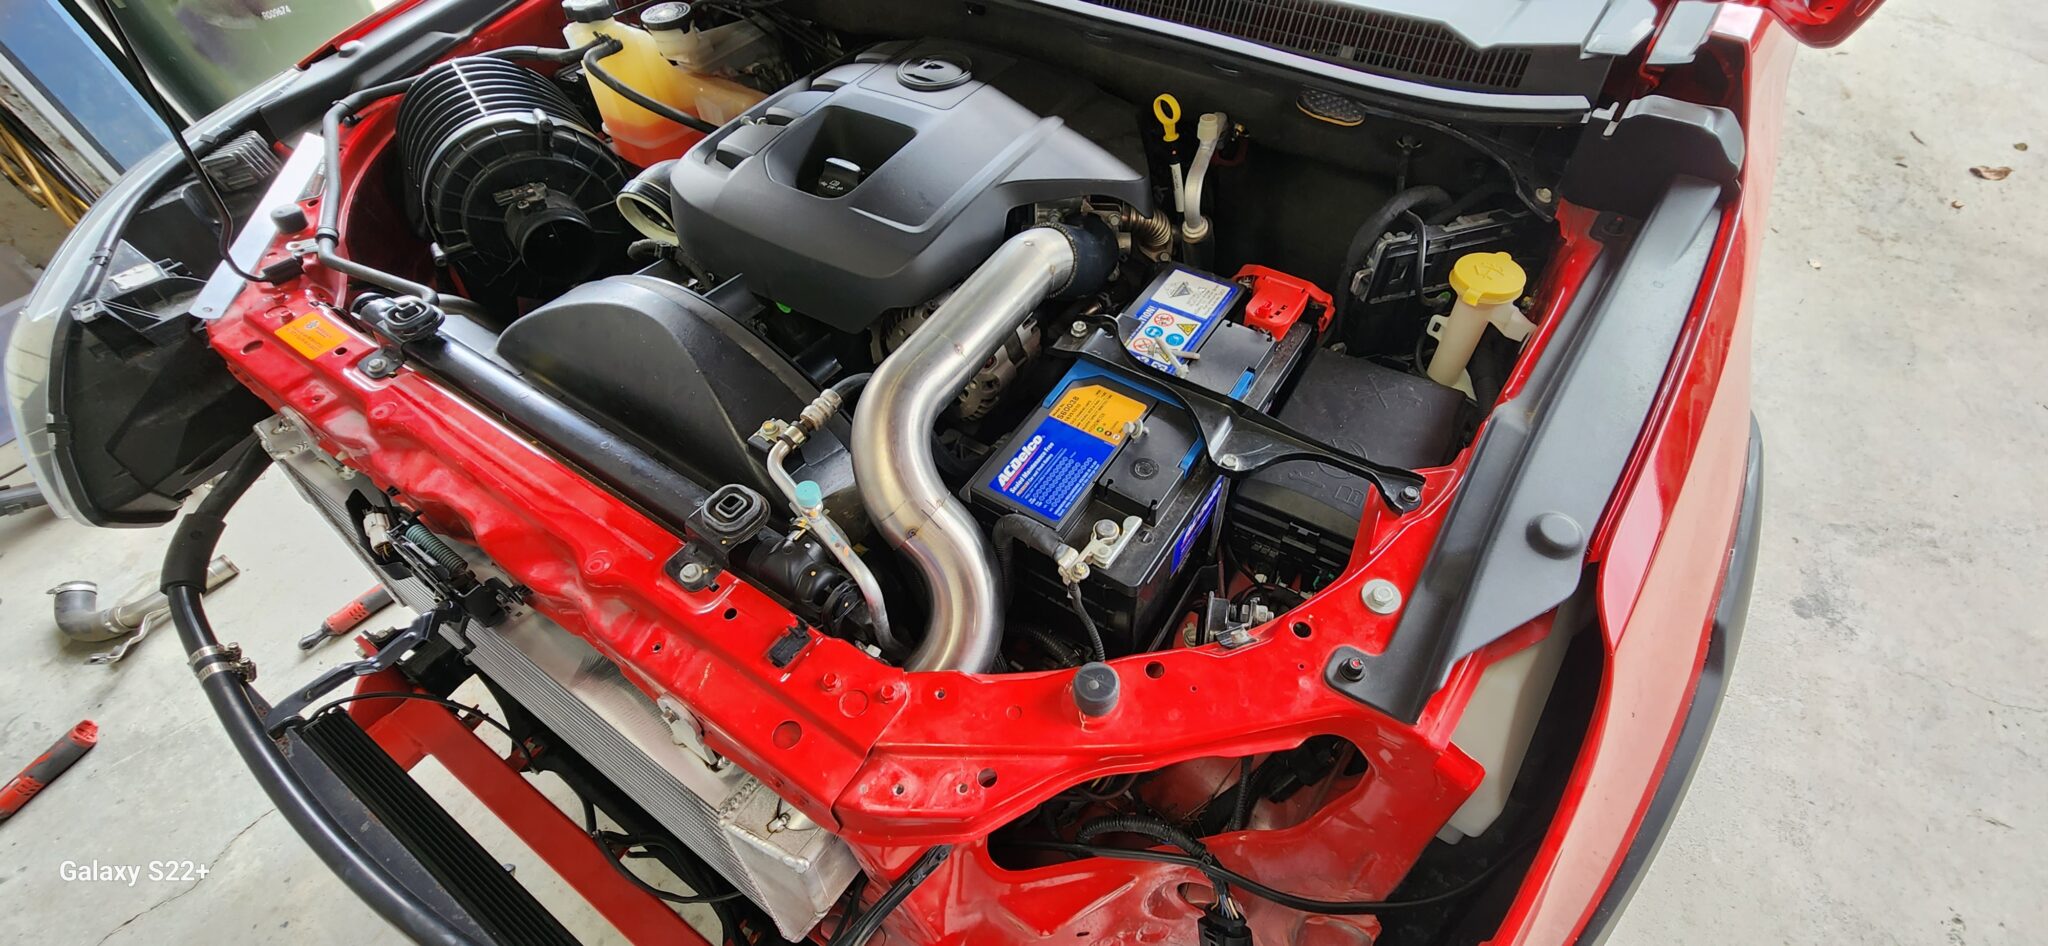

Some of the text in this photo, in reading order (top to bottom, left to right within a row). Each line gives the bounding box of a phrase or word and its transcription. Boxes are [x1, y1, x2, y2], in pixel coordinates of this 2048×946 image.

[998, 435, 1043, 488] ACDelco
[1009, 477, 1025, 493] Sealed
[1022, 451, 1047, 479] Maintenance
[1043, 442, 1055, 453] Free
